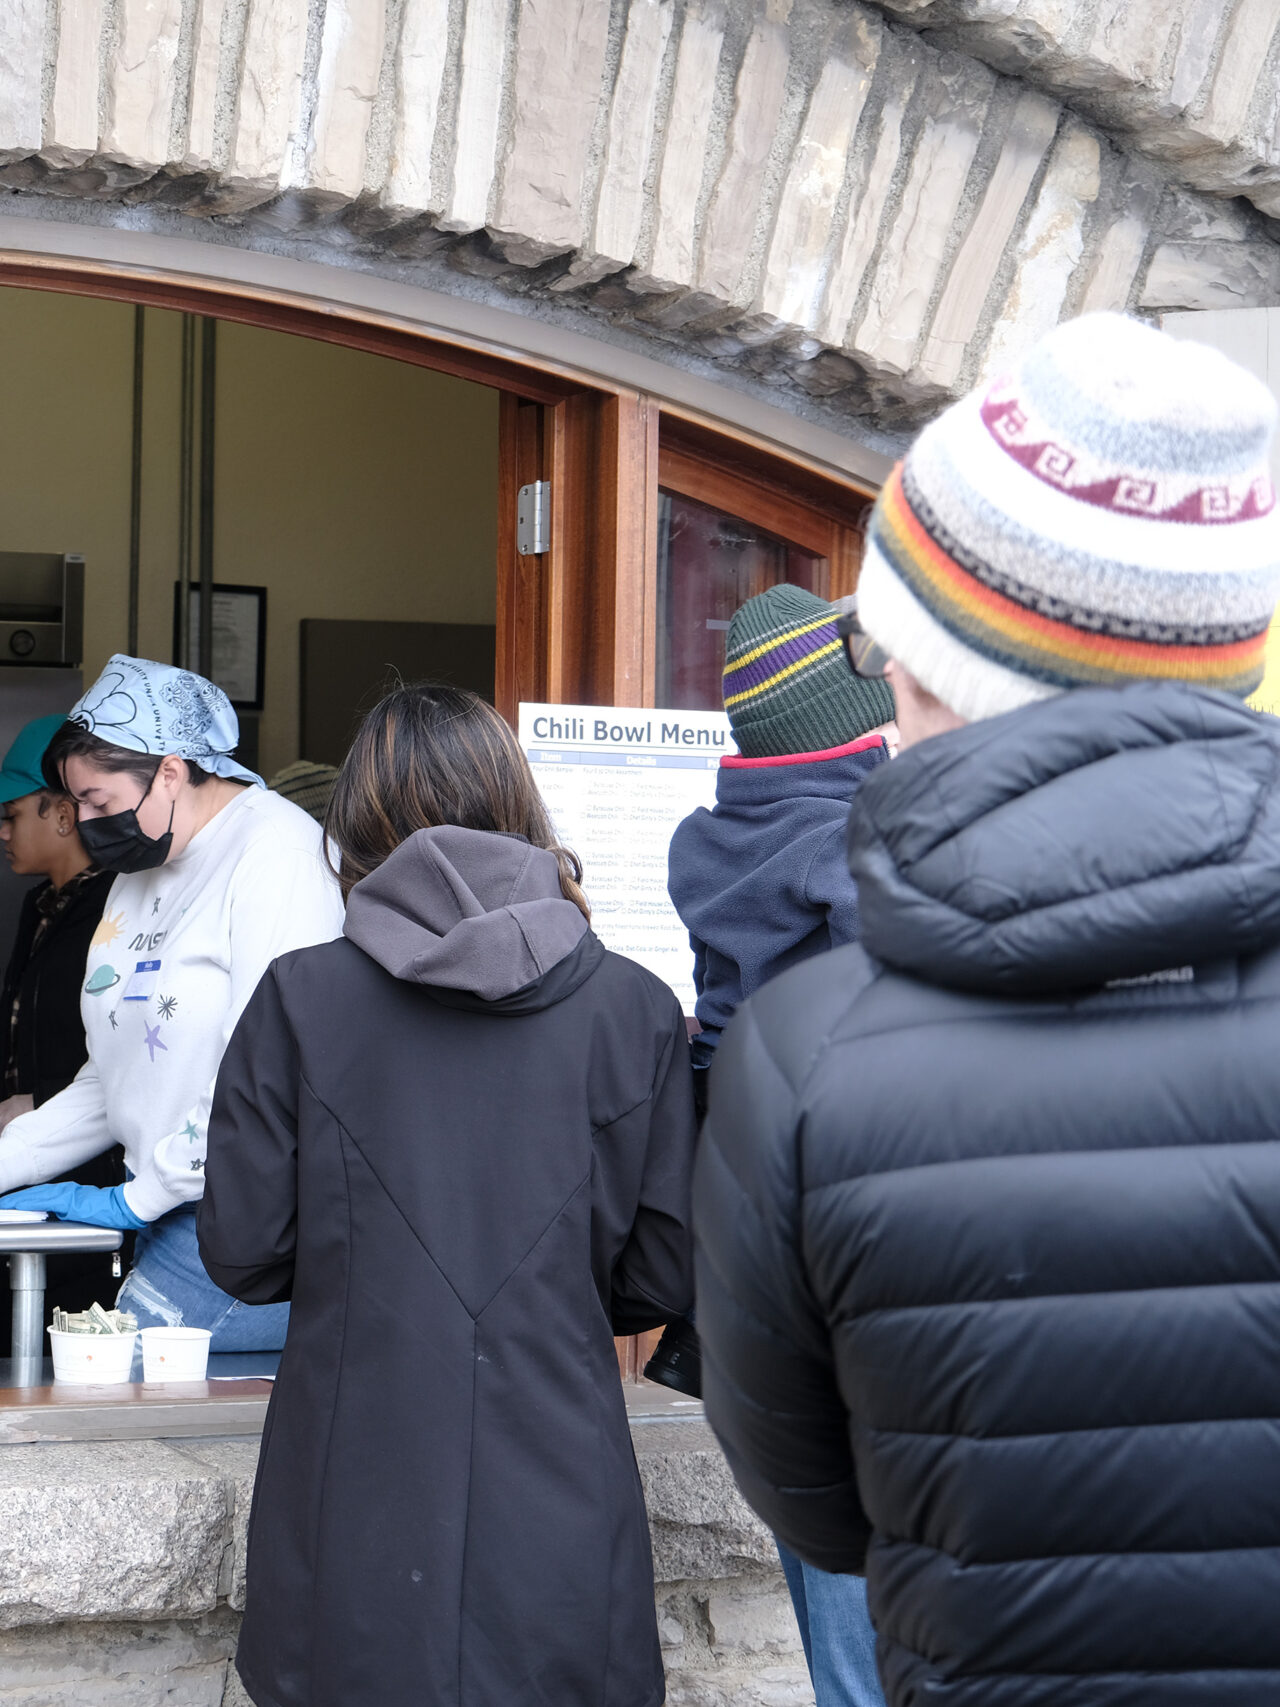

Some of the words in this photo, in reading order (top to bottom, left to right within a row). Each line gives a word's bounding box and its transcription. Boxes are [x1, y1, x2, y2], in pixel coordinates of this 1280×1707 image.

[533, 717, 585, 740] Chili
[593, 720, 652, 743] Bowl
[661, 723, 726, 746] Menu
[540, 752, 562, 762] Item
[626, 756, 657, 766] Details
